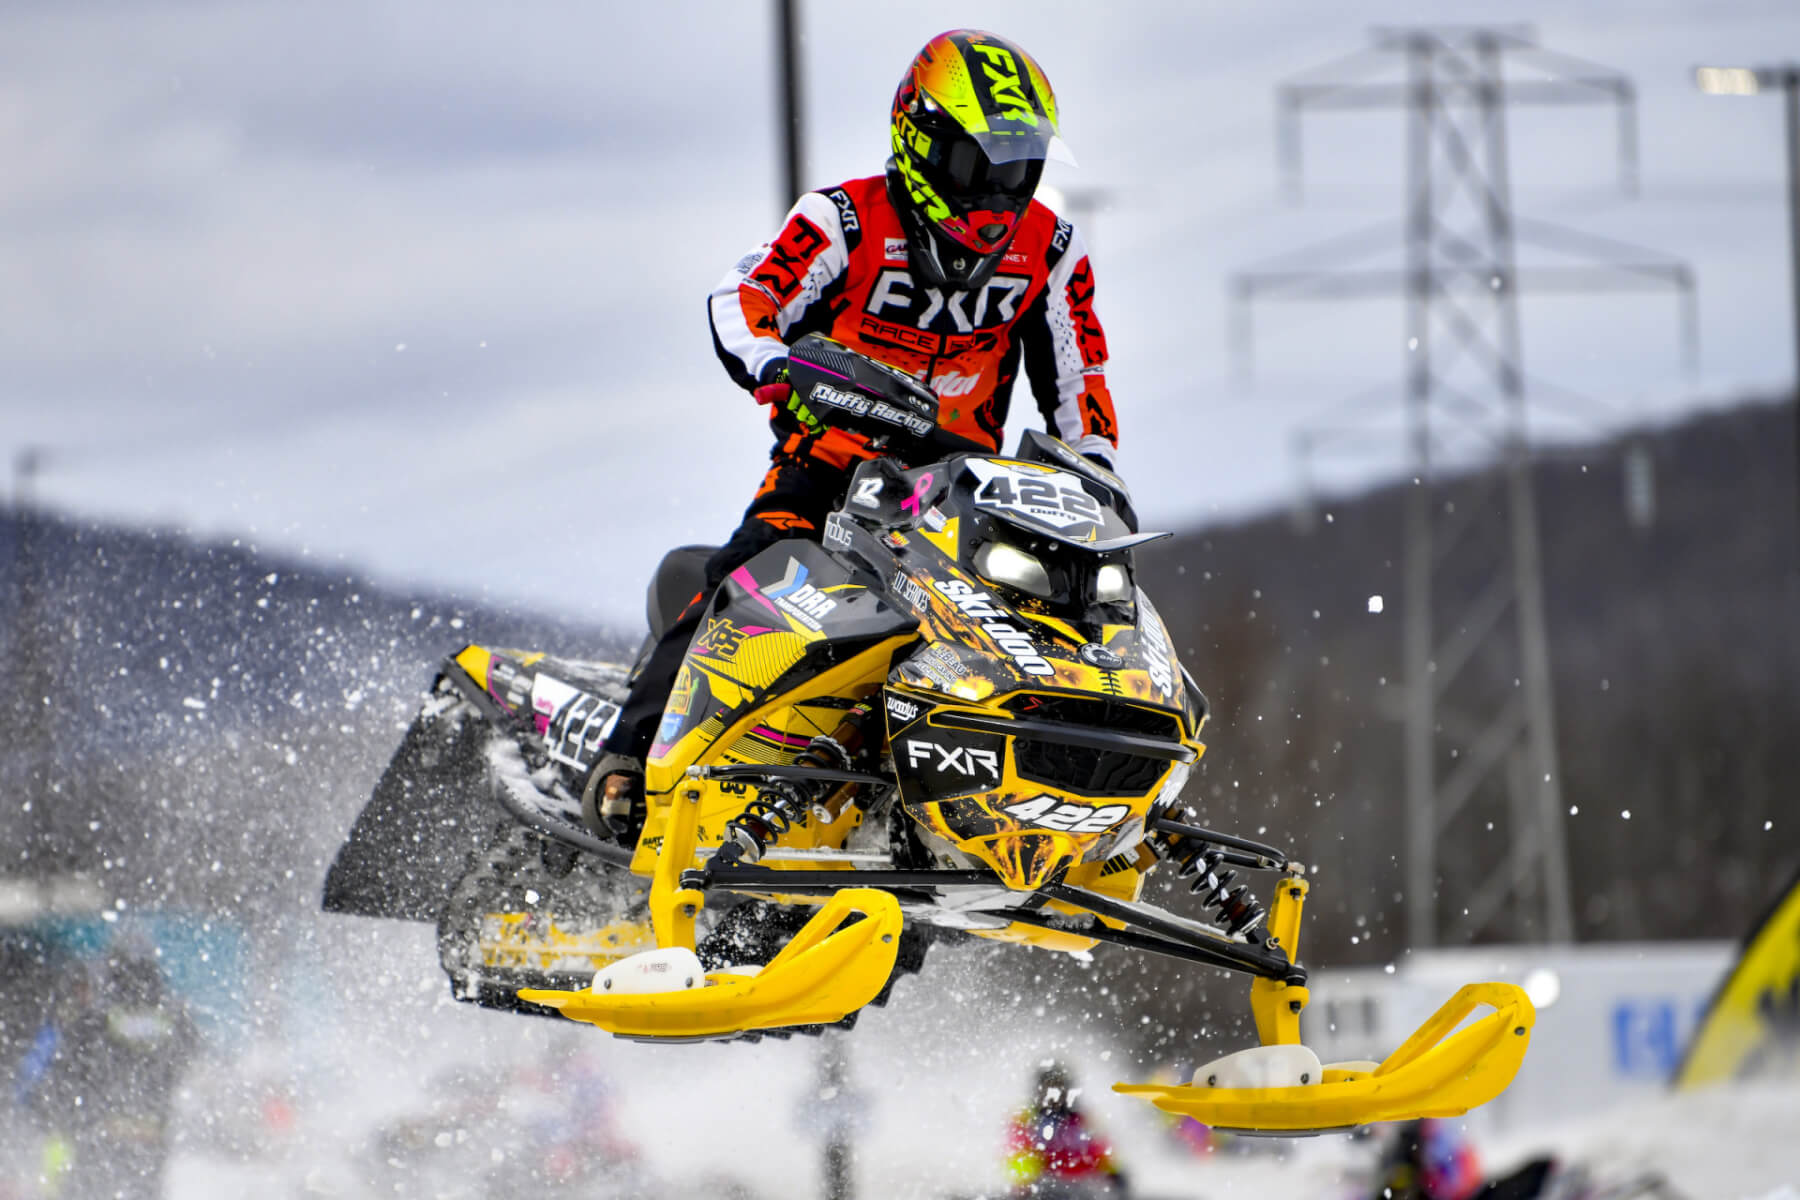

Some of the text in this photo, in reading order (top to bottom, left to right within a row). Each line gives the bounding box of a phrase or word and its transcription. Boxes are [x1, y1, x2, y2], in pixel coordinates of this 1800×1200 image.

[971, 44, 1039, 128] FXR
[830, 190, 859, 232] FXR
[755, 217, 824, 298] FXR
[866, 270, 1030, 333] FXR
[861, 318, 936, 349] RACE
[811, 383, 872, 416] Duffy
[869, 402, 934, 436] Racing
[979, 476, 1101, 524] 422
[697, 618, 749, 658] XPS
[907, 739, 999, 779] FXR
[1003, 794, 1131, 833] 422
